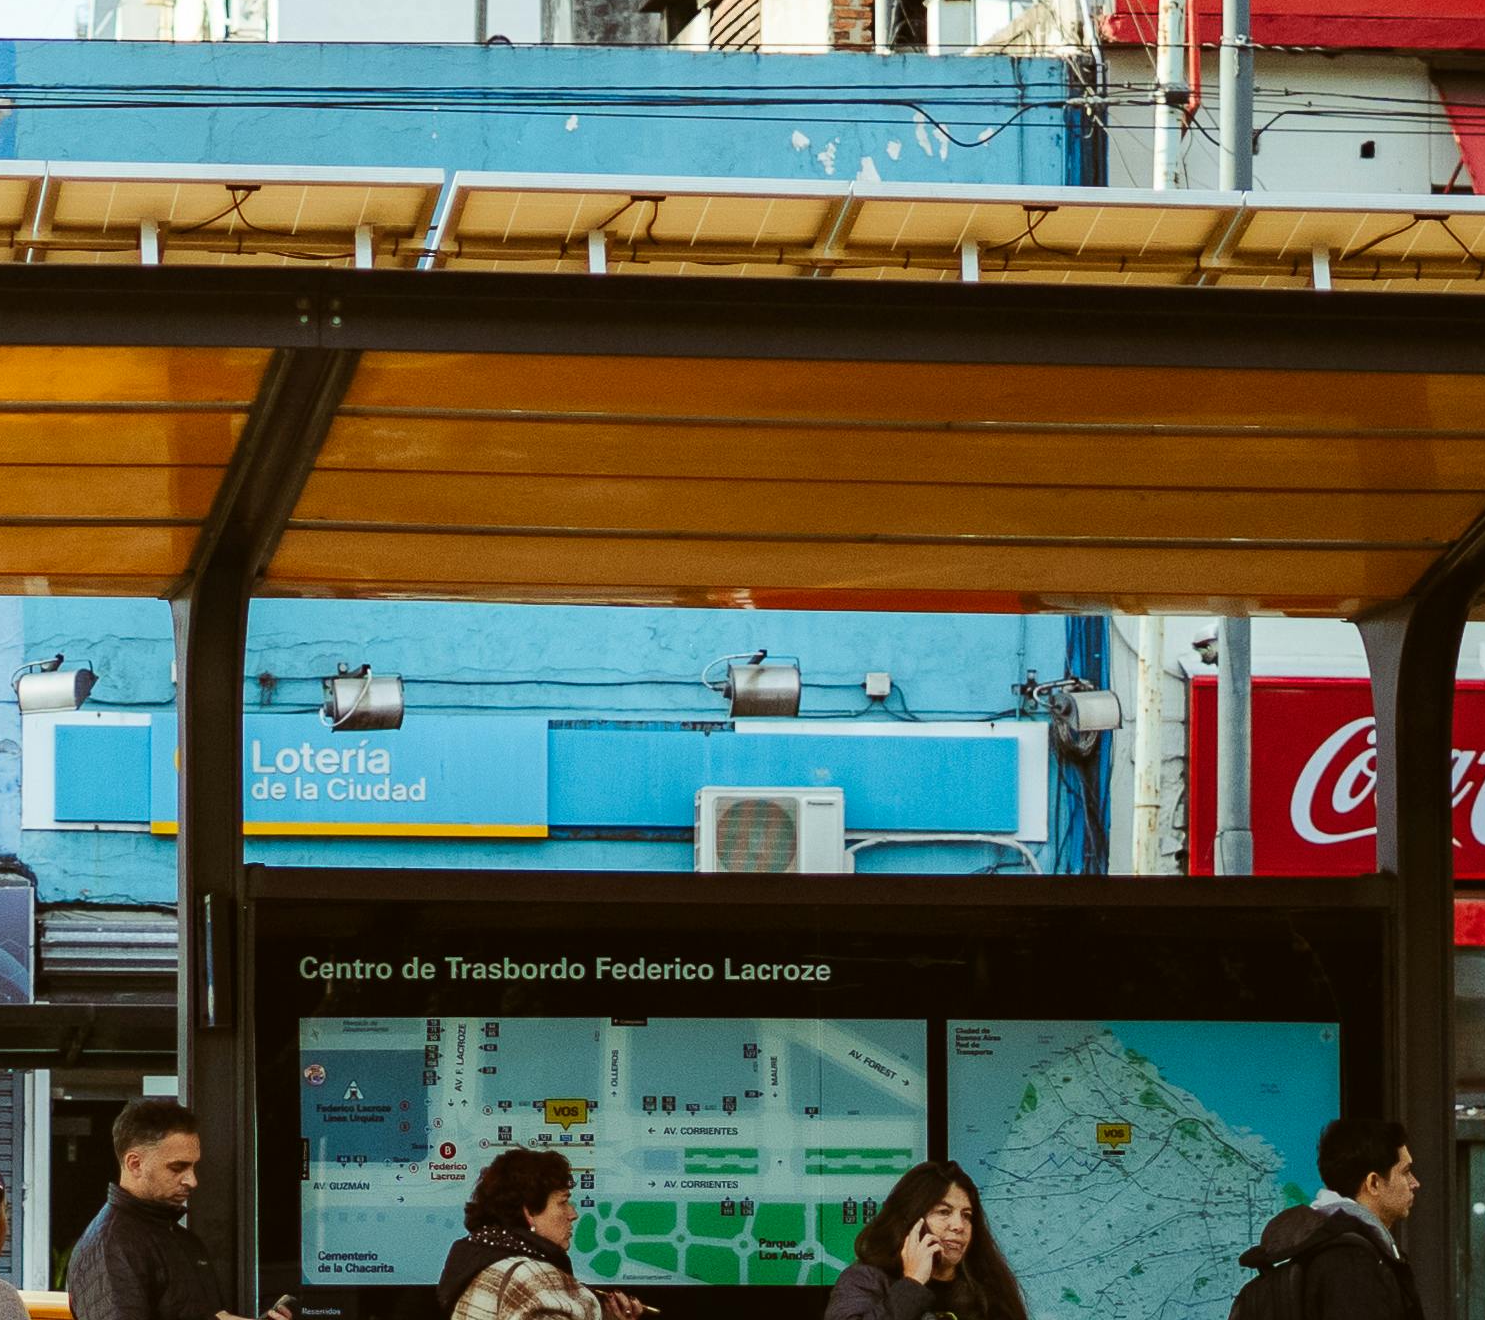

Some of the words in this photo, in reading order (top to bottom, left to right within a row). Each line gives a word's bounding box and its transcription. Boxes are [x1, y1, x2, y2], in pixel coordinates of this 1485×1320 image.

[251, 738, 391, 775] Lotería
[251, 777, 287, 801] de
[295, 777, 319, 801] la
[327, 777, 427, 802] Ciudad
[299, 956, 393, 980] Centro
[401, 956, 436, 980] de
[444, 956, 586, 981] Trasbordo
[595, 957, 714, 982] Federico
[724, 958, 832, 982] Lacroze
[455, 1023, 467, 1066] LACROZE
[610, 1049, 620, 1087] OLLEROS
[848, 1049, 862, 1061] AV.
[864, 1056, 898, 1080] FOREST
[771, 1056, 779, 1086] MAURE
[552, 1106, 580, 1117] VOS
[663, 1127, 678, 1136] AV.
[680, 1127, 739, 1136] CORRIENTES
[1103, 1129, 1125, 1139] VOS
[428, 1162, 468, 1171] Federico
[430, 1171, 466, 1181] Lacroze
[329, 1180, 370, 1190] GUZMÁN
[663, 1180, 678, 1189] AV.
[680, 1180, 739, 1189] CORRIENTES
[758, 1238, 797, 1249] Parque
[317, 1251, 379, 1261] Cementerio
[758, 1250, 778, 1260] Los
[781, 1250, 815, 1260] Andes
[317, 1263, 331, 1273] de
[333, 1263, 343, 1273] la
[345, 1263, 395, 1273] Chacarita
